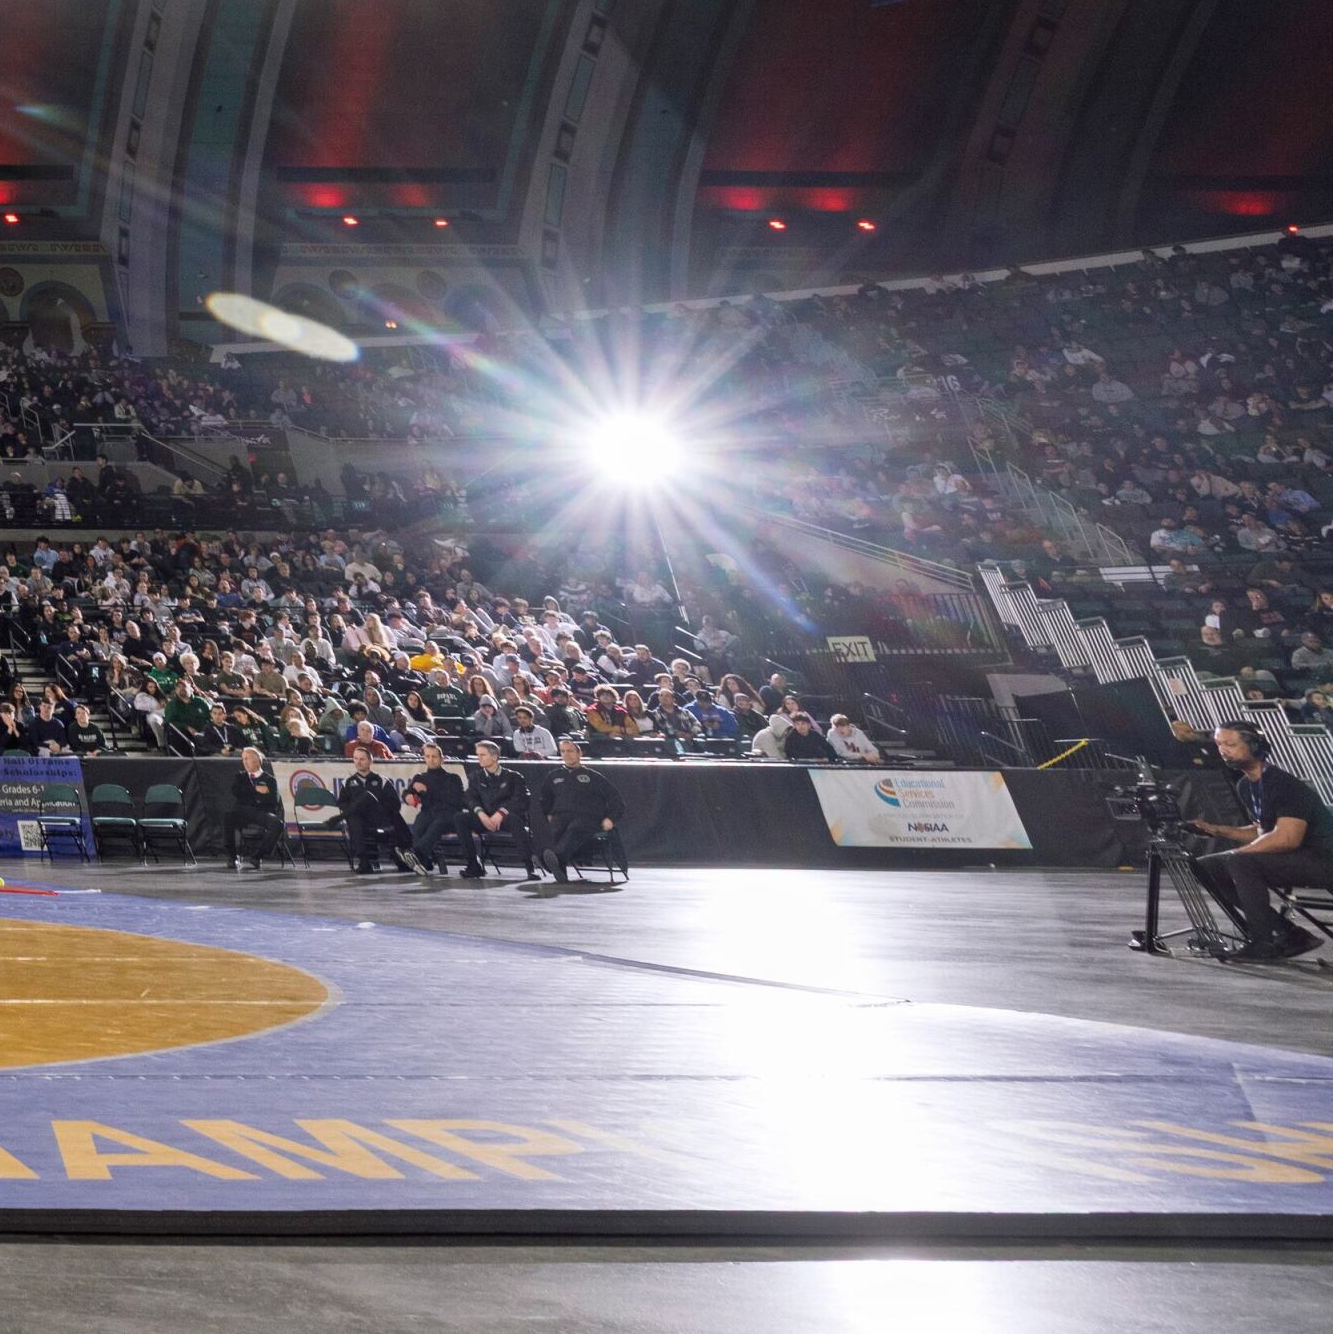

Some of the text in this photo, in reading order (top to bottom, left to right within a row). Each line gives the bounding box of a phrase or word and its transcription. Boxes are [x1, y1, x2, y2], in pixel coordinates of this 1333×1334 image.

[832, 641, 868, 657] EXIT
[894, 778, 945, 788] Educational
[2, 784, 31, 795] Grades
[14, 798, 29, 807] and
[903, 799, 955, 809] Commission
